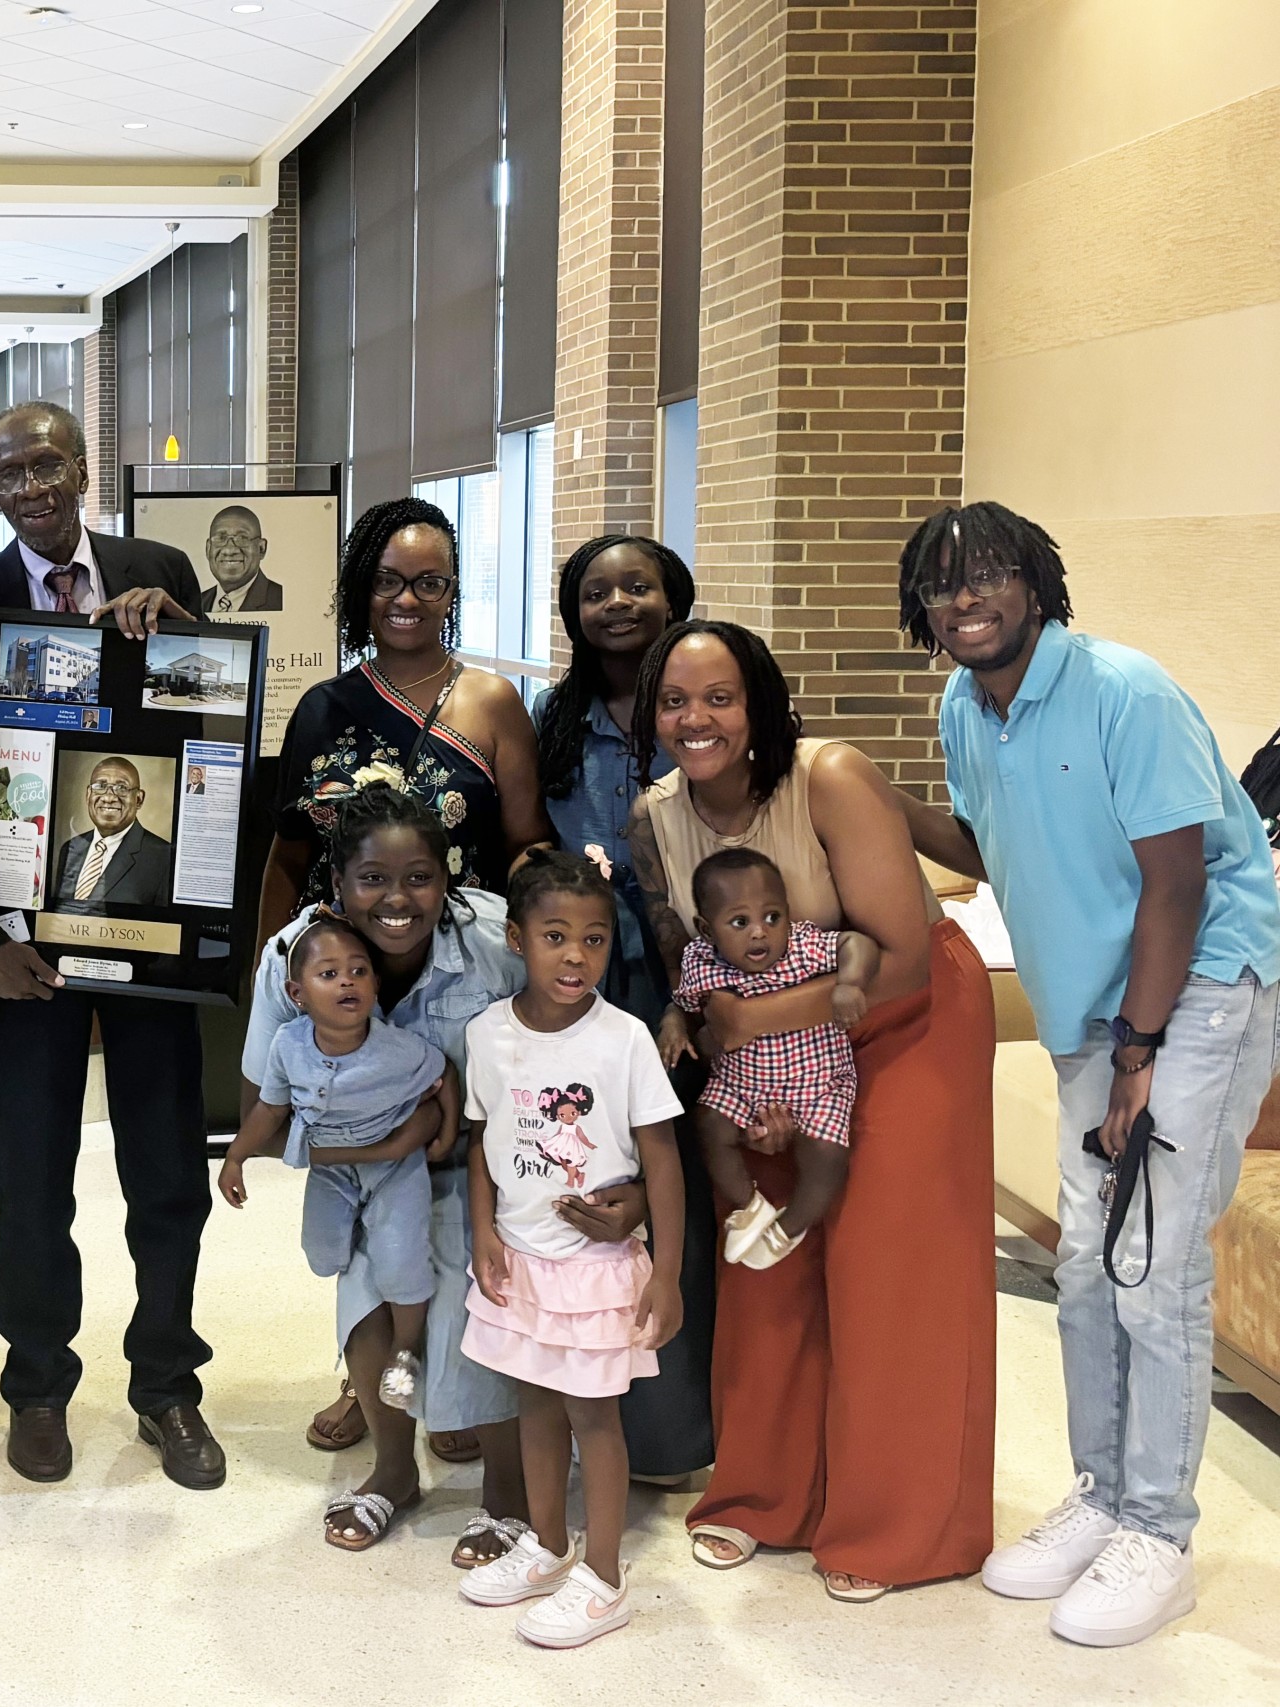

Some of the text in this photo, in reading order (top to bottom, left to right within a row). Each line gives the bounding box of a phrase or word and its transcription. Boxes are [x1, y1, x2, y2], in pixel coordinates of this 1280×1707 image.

[266, 652, 322, 672] ng Hall
[0, 748, 41, 762] MENU
[10, 780, 47, 813] food
[70, 924, 145, 941] MR DYSON
[511, 1089, 533, 1107] TO
[517, 1117, 545, 1130] KIND
[516, 1136, 536, 1147] SMAR
[514, 1153, 553, 1178] Girl
